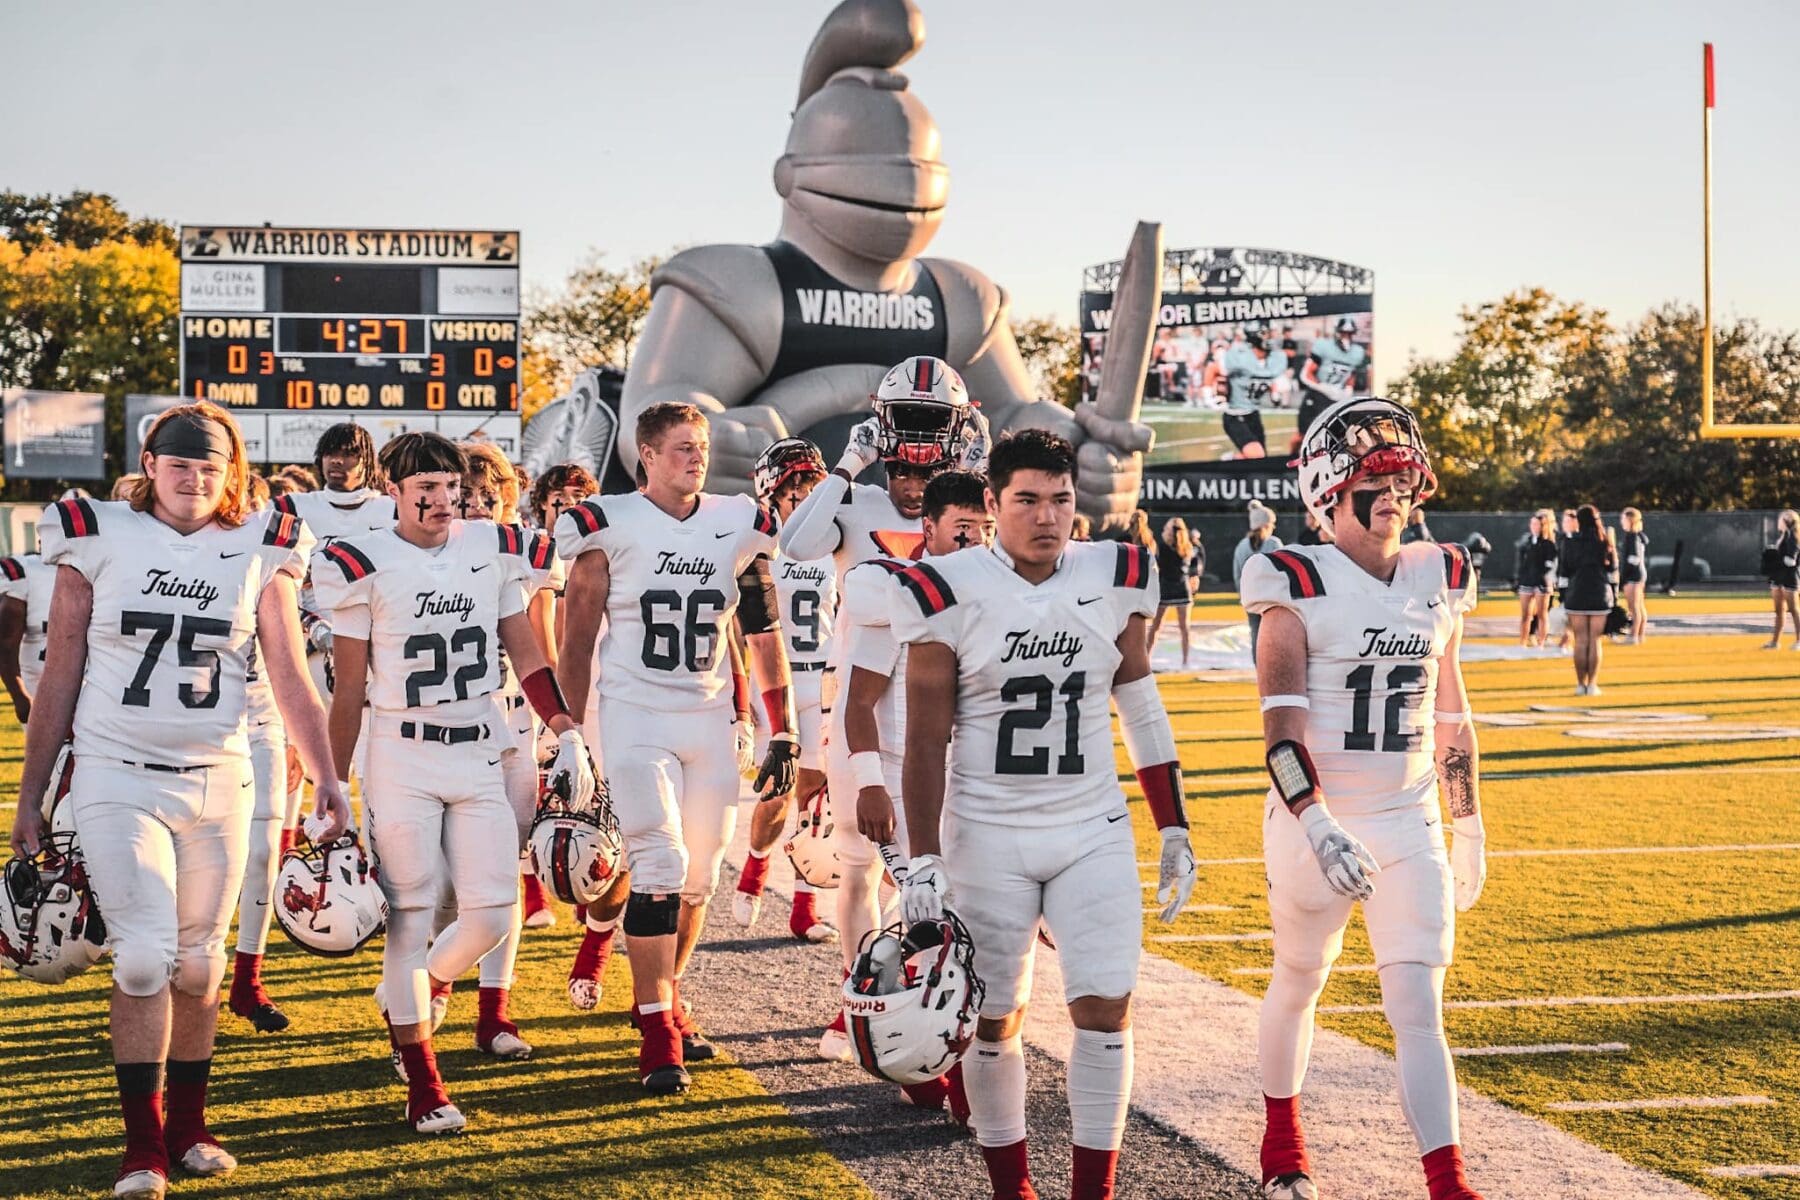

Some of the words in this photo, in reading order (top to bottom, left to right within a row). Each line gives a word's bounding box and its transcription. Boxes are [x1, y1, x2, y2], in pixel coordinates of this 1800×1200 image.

[227, 231, 348, 255] WARRIOR
[356, 233, 473, 257] STADIUM
[190, 285, 256, 297] MULLEN
[213, 271, 254, 283] GINA
[796, 288, 935, 330] WARRIORS
[1195, 296, 1309, 323] ENTRANCE
[185, 318, 272, 338] HOME
[322, 319, 407, 353] 4:27
[431, 321, 515, 341] VISITOR
[228, 345, 248, 374] 0
[259, 351, 275, 375] 3
[430, 353, 445, 376] 3
[474, 348, 493, 376] 0
[207, 383, 258, 405] DOWN
[286, 380, 314, 409] 10
[318, 383, 341, 406] TO
[346, 383, 370, 407] GO
[380, 384, 404, 407] ON
[426, 381, 446, 410] 0
[458, 384, 497, 407] QTR
[510, 382, 518, 410] 1
[1198, 479, 1299, 500] MULLEN
[654, 551, 717, 585] Trinity
[781, 562, 827, 587] Trinity
[141, 568, 219, 611] Trinity
[414, 590, 475, 622] Trinity
[640, 589, 727, 672] 66
[791, 590, 821, 652] 9
[1000, 629, 1083, 667] Trinity
[1358, 627, 1432, 660] Trinity
[121, 610, 233, 709] 75
[403, 625, 488, 708] 22
[995, 671, 1087, 775] 21
[1343, 665, 1429, 752] 12
